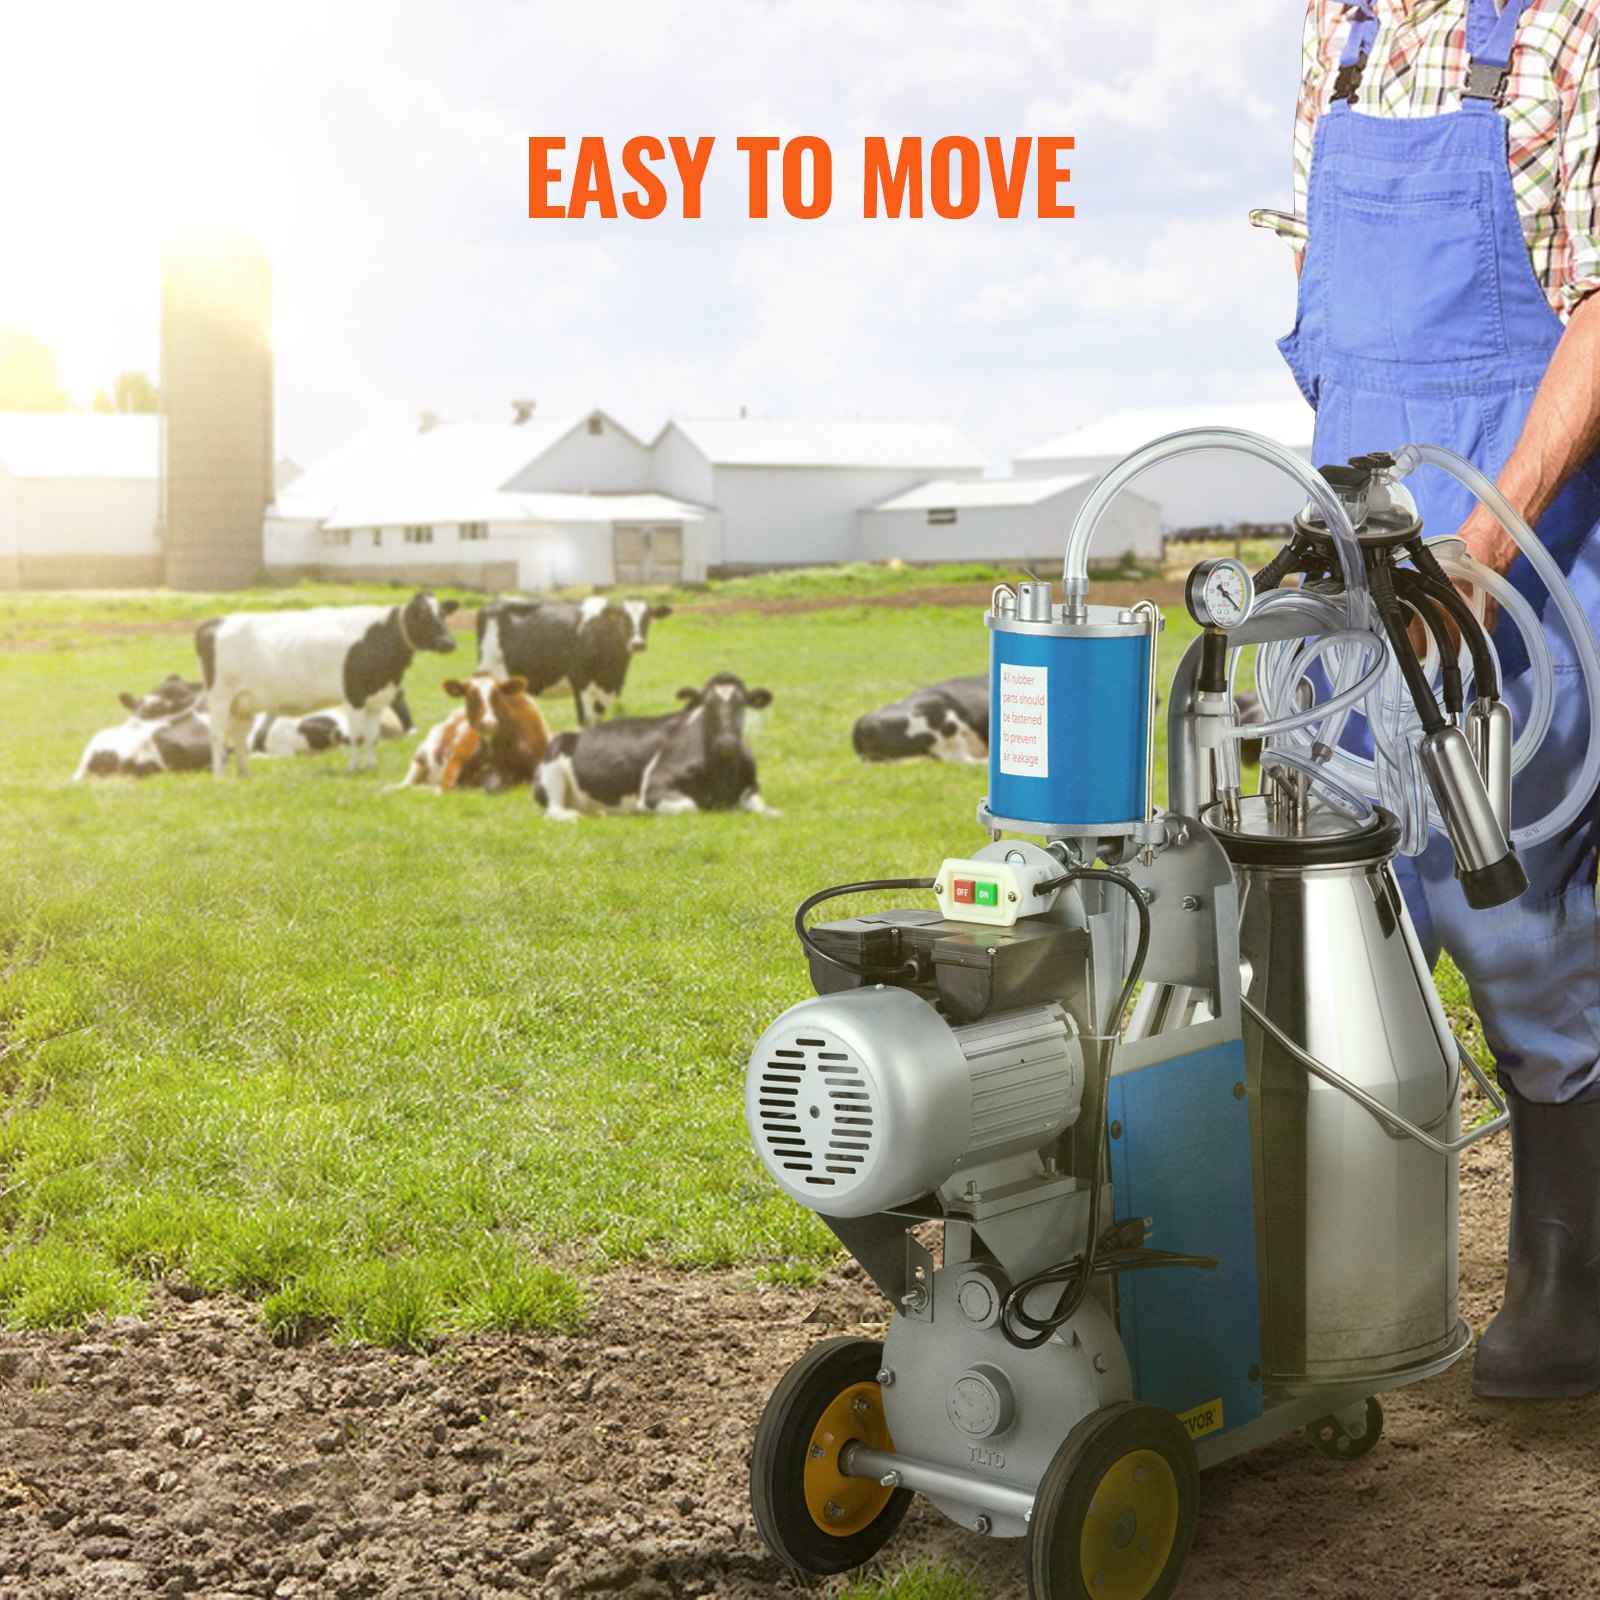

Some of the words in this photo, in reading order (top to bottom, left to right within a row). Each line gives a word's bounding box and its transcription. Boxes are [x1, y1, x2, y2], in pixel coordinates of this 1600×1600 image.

[1003, 671, 1011, 682] All
[1011, 673, 1035, 685] rubber
[1003, 693, 1018, 705] parts
[1019, 694, 1045, 706] should
[1003, 712, 1011, 723] be
[1011, 712, 1042, 725] fastened
[1003, 732, 1010, 742] to
[1010, 734, 1037, 746] prevent
[1003, 751, 1011, 761] air
[1011, 751, 1039, 767] leakage
[956, 887, 969, 897] OFF
[979, 890, 989, 899] ON
[967, 1446, 1006, 1470] TLTD
